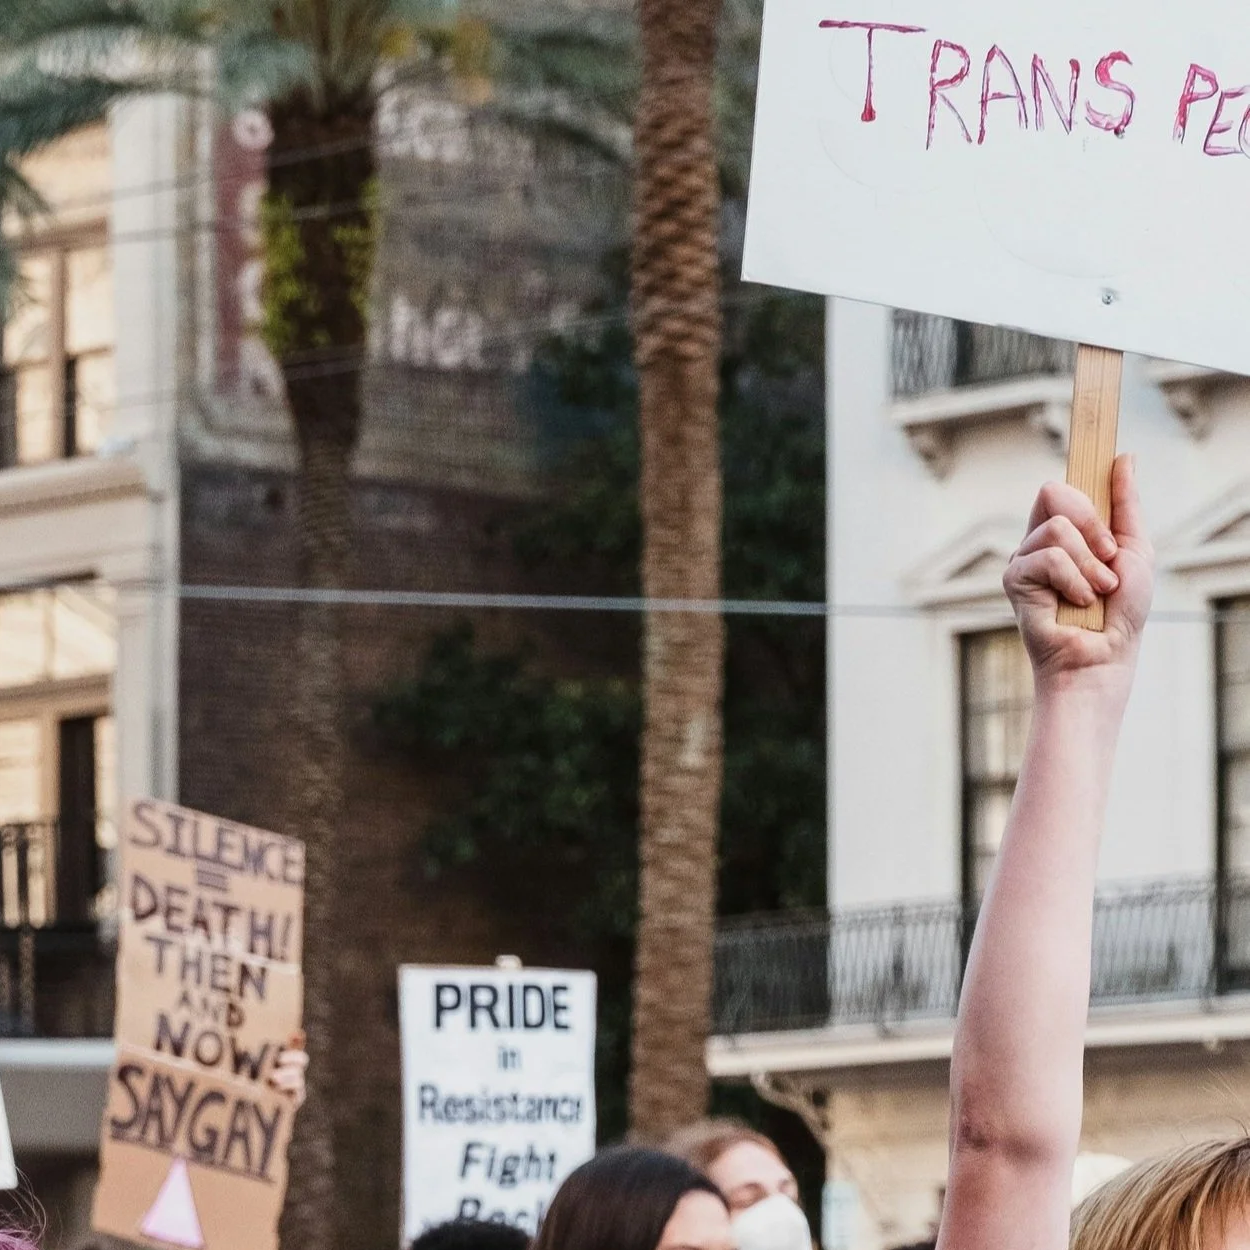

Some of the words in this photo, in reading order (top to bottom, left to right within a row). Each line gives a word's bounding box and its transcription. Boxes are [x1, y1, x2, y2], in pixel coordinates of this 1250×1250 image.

[818, 19, 1136, 150] TRANS
[1172, 63, 1250, 159] PE
[130, 802, 304, 885] SILENCE
[132, 873, 292, 961] DEATH!
[145, 935, 267, 999] THEN
[434, 983, 570, 1030] PRIDE
[499, 1046, 521, 1070] in
[459, 1141, 556, 1188] Fight
